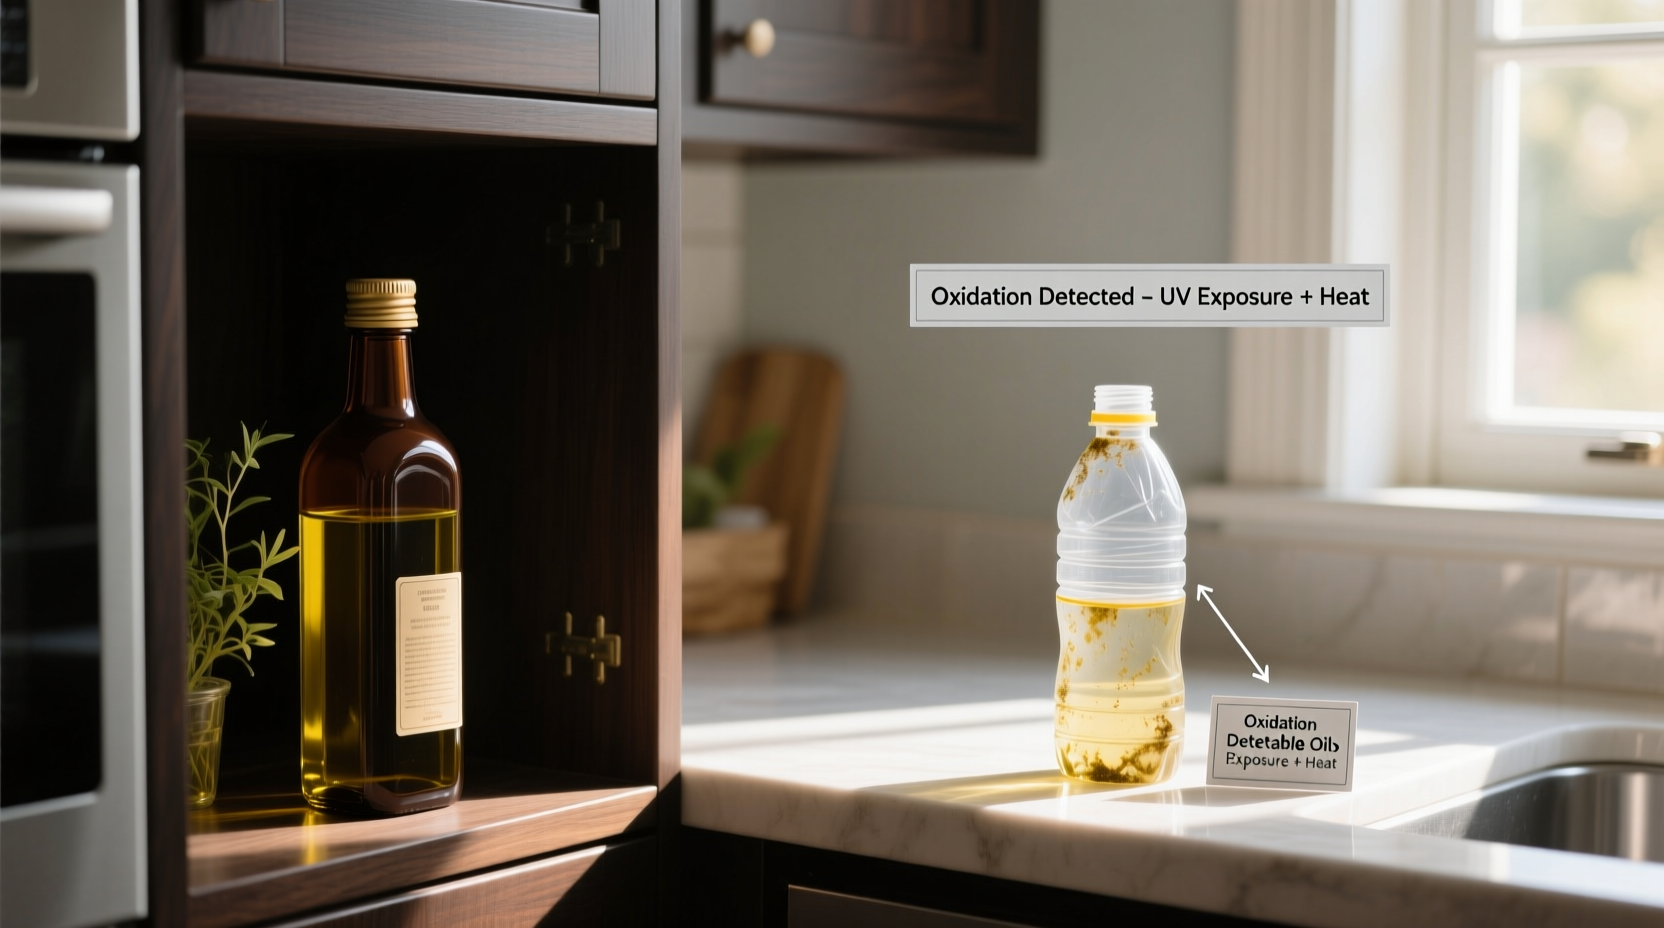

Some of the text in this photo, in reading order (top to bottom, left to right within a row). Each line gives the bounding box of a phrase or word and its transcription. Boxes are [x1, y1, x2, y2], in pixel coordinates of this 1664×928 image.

[1244, 714, 1317, 731] Oxidation
[1226, 751, 1337, 770] Exposure + Heat
